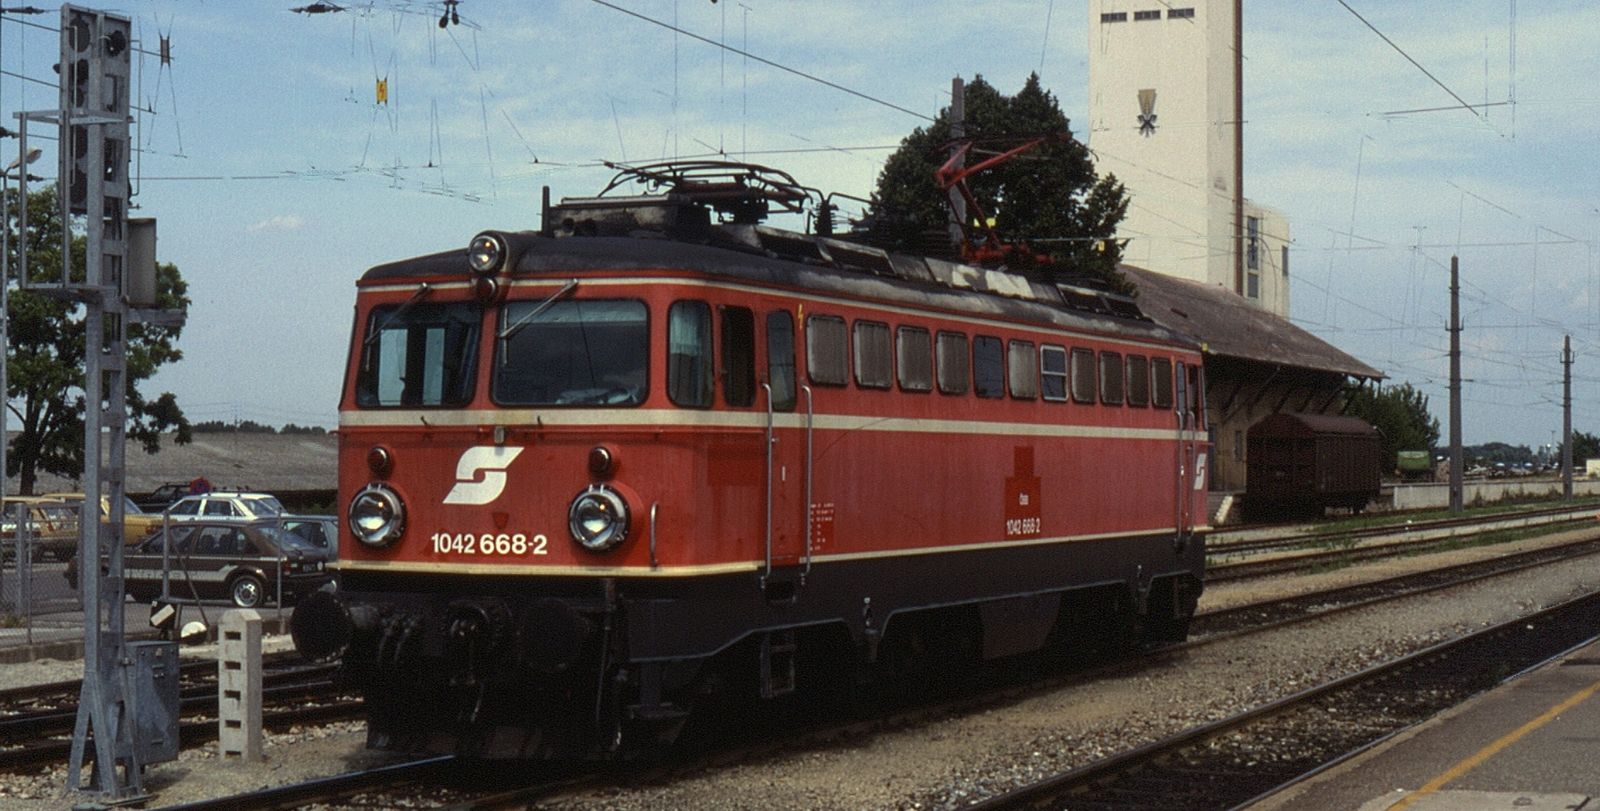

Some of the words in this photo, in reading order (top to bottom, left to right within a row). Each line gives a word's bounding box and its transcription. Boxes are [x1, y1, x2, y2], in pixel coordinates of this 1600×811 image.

[1006, 519, 1021, 535] 1042
[431, 533, 475, 554] 1042
[479, 533, 548, 555] 668-2
